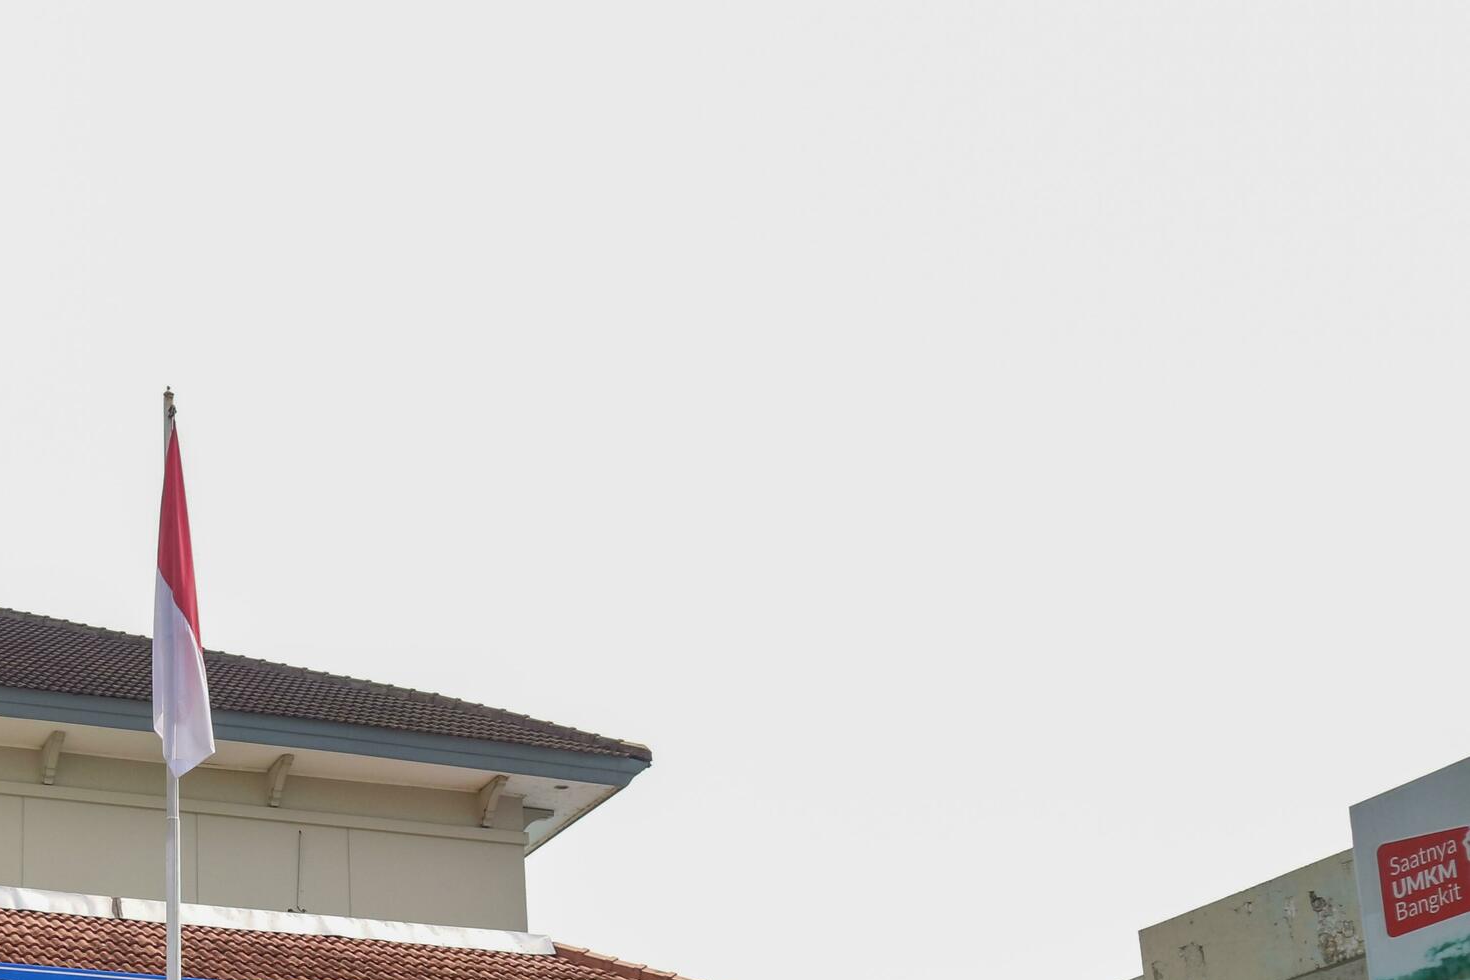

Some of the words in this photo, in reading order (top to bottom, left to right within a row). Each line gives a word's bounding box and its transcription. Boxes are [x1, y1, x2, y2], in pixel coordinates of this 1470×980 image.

[1389, 839, 1458, 876] Saatnya
[1391, 858, 1458, 899] UMKM
[1395, 883, 1463, 922] Bangkit
